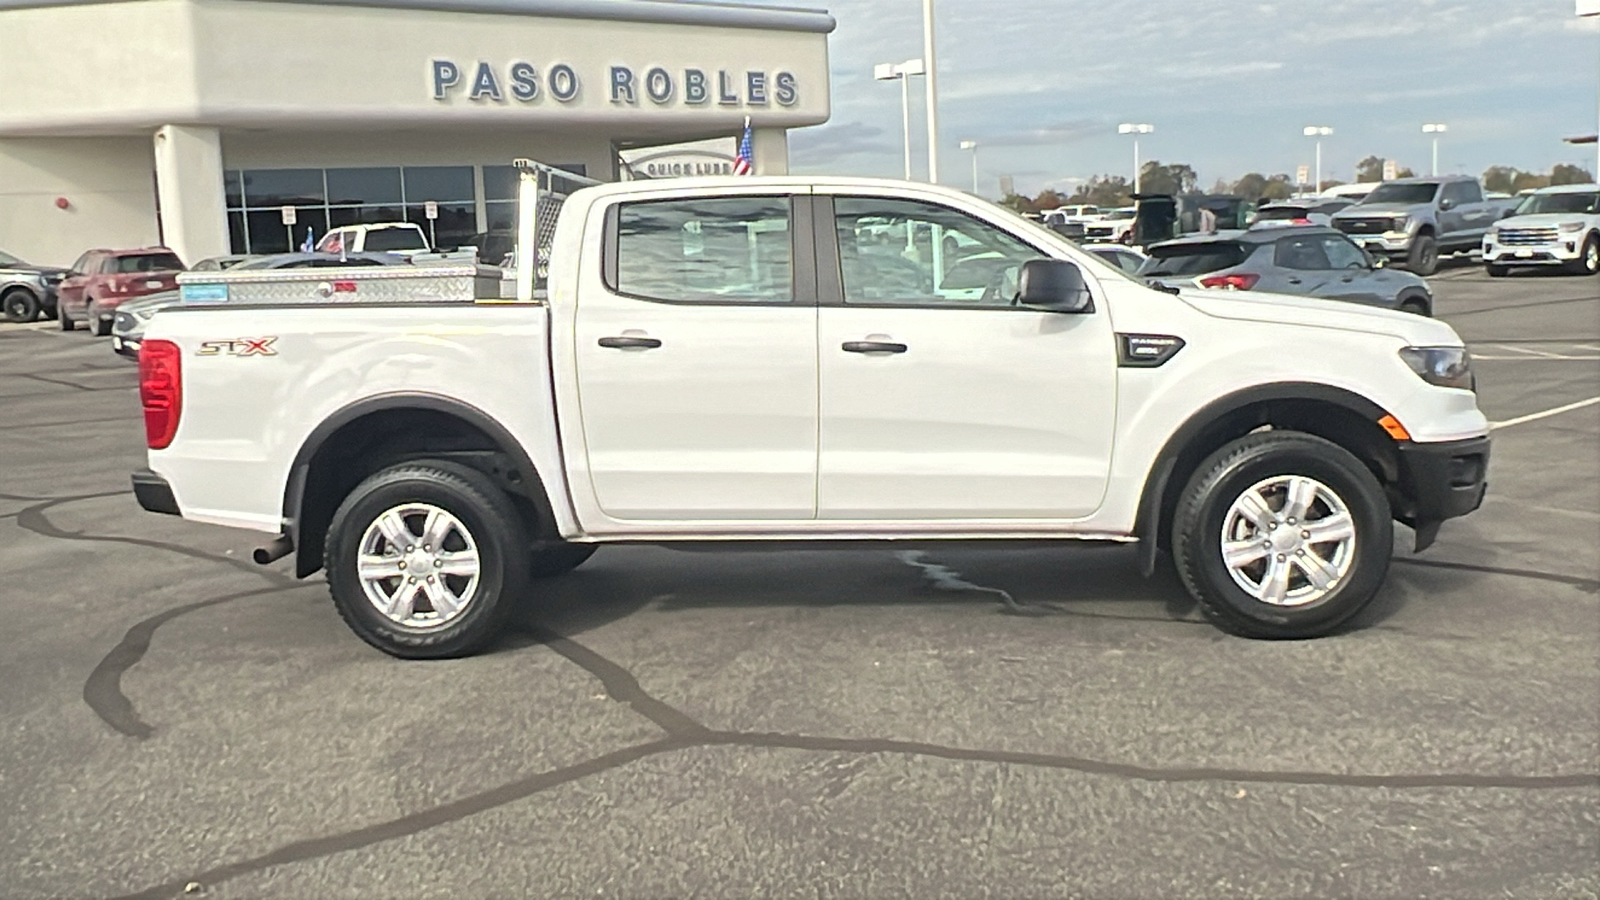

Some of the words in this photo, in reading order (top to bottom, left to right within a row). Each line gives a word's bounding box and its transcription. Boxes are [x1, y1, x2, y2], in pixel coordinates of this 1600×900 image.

[432, 60, 579, 102] PASO
[609, 65, 797, 106] ROBLES
[647, 162, 693, 176] QUICK
[195, 336, 278, 356] STX
